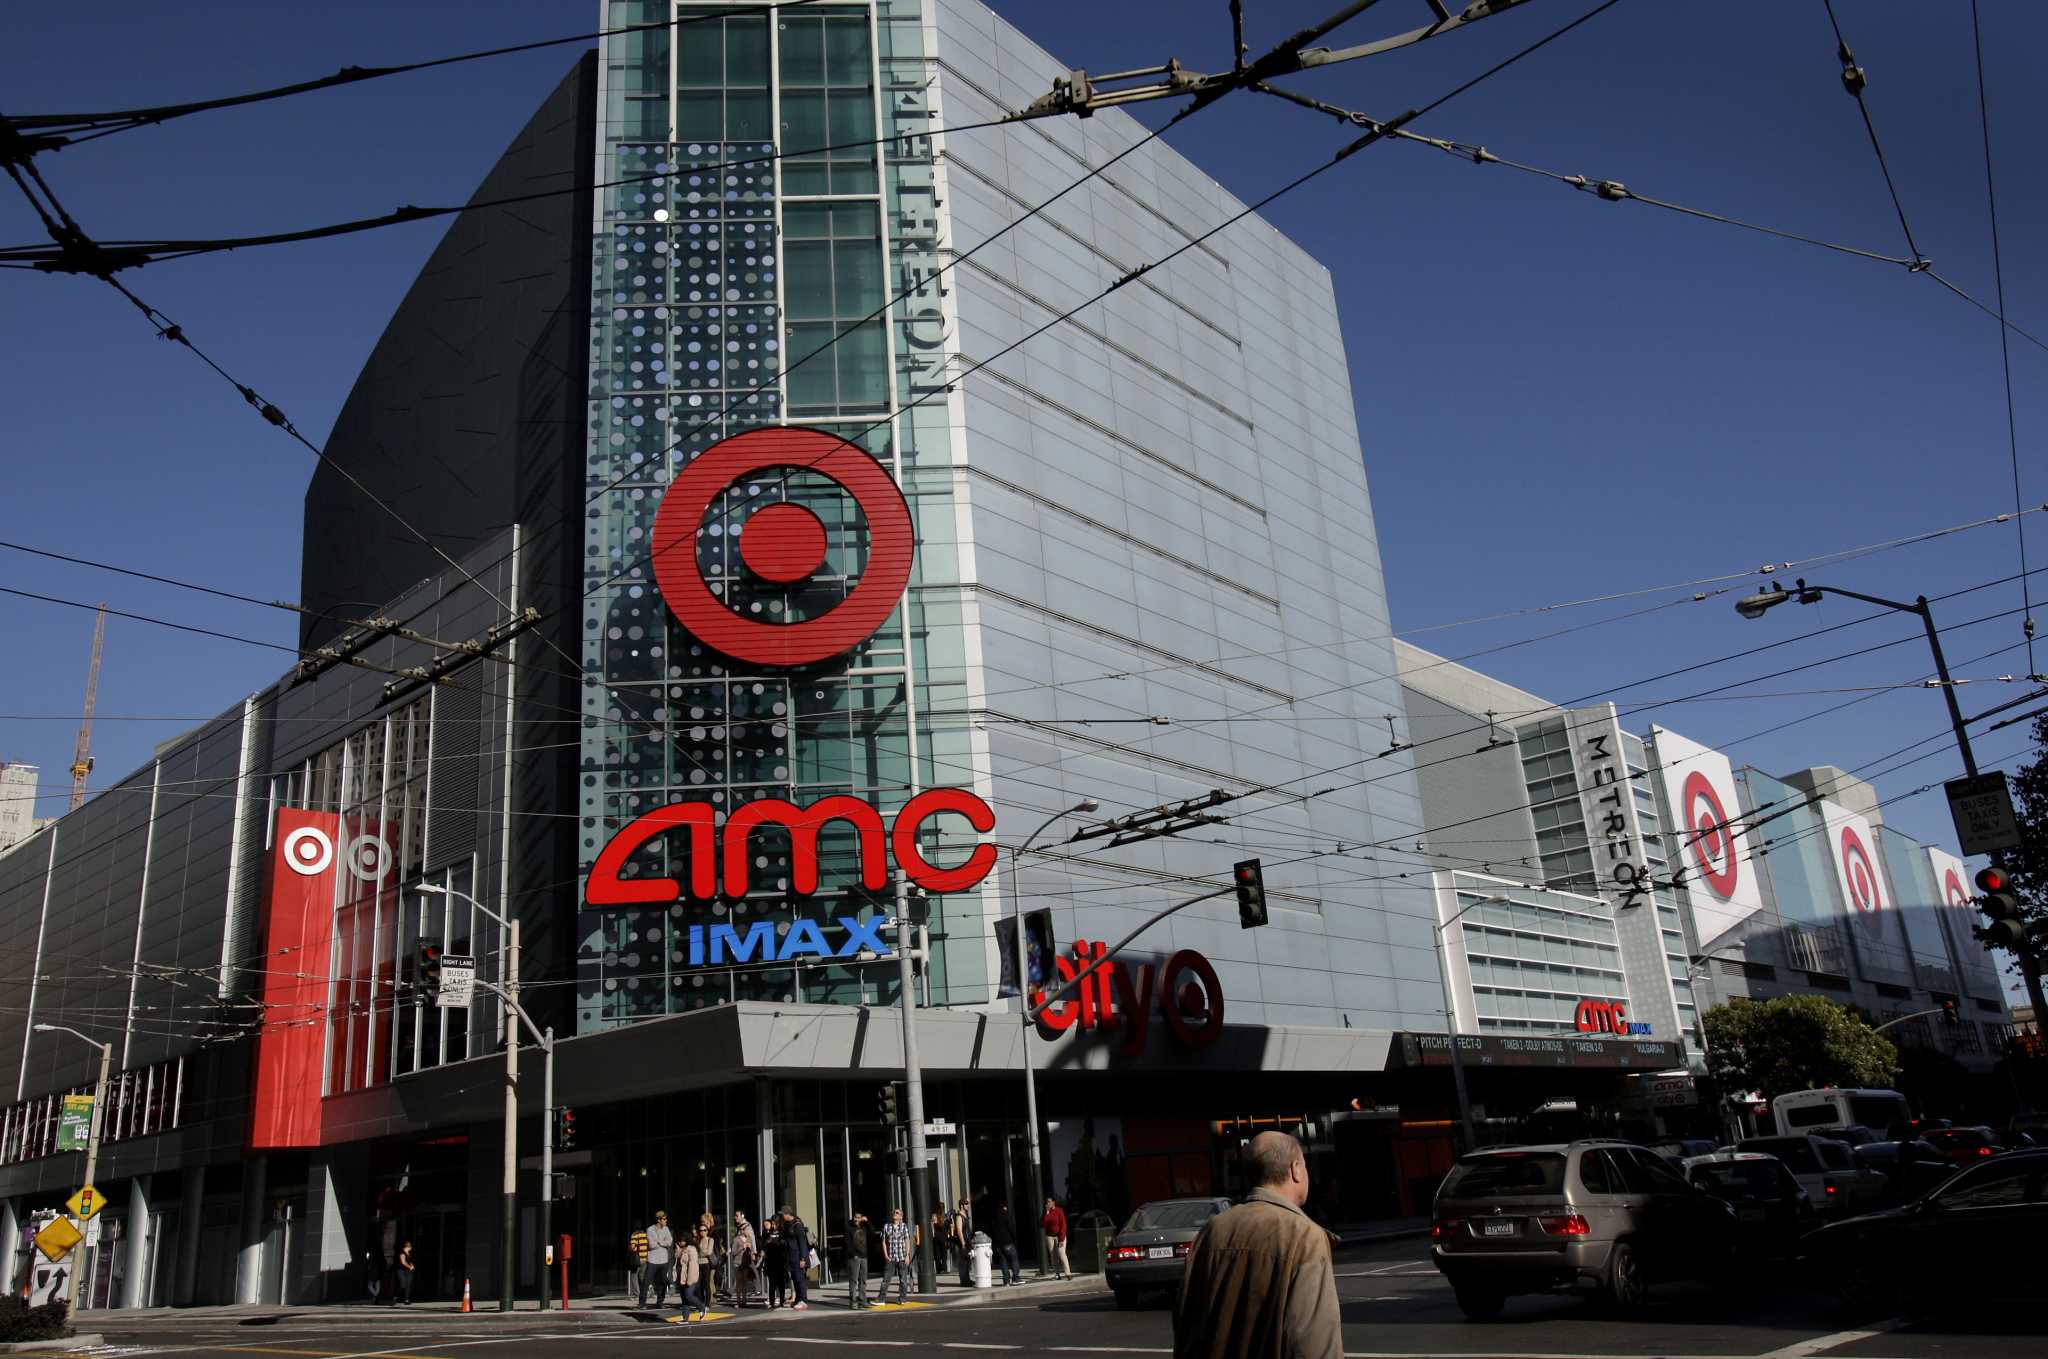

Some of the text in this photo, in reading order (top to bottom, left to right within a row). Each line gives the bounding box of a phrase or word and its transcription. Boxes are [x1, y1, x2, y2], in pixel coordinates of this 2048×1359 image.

[892, 75, 955, 393] METREON
[1588, 734, 1642, 910] METREON
[688, 914, 892, 965] IMAX
[1420, 1036, 1443, 1049] PITCH
